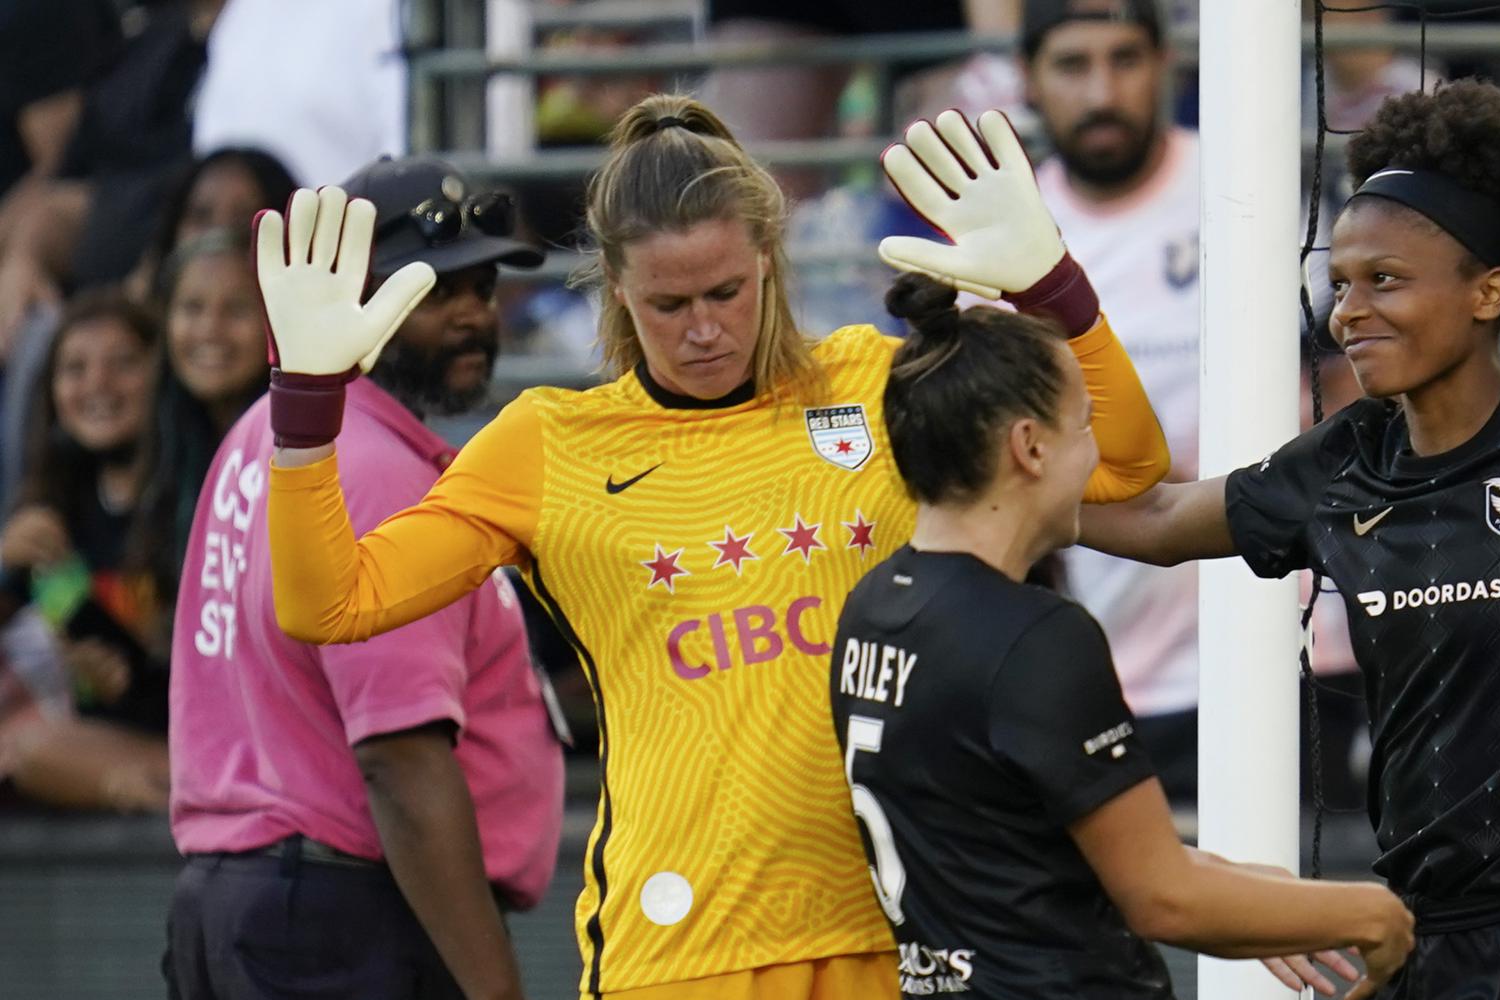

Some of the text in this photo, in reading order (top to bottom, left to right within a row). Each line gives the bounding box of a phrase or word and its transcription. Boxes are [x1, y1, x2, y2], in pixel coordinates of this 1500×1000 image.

[667, 595, 831, 680] CIBC
[840, 637, 918, 707] RILEY
[845, 714, 906, 926] 5
